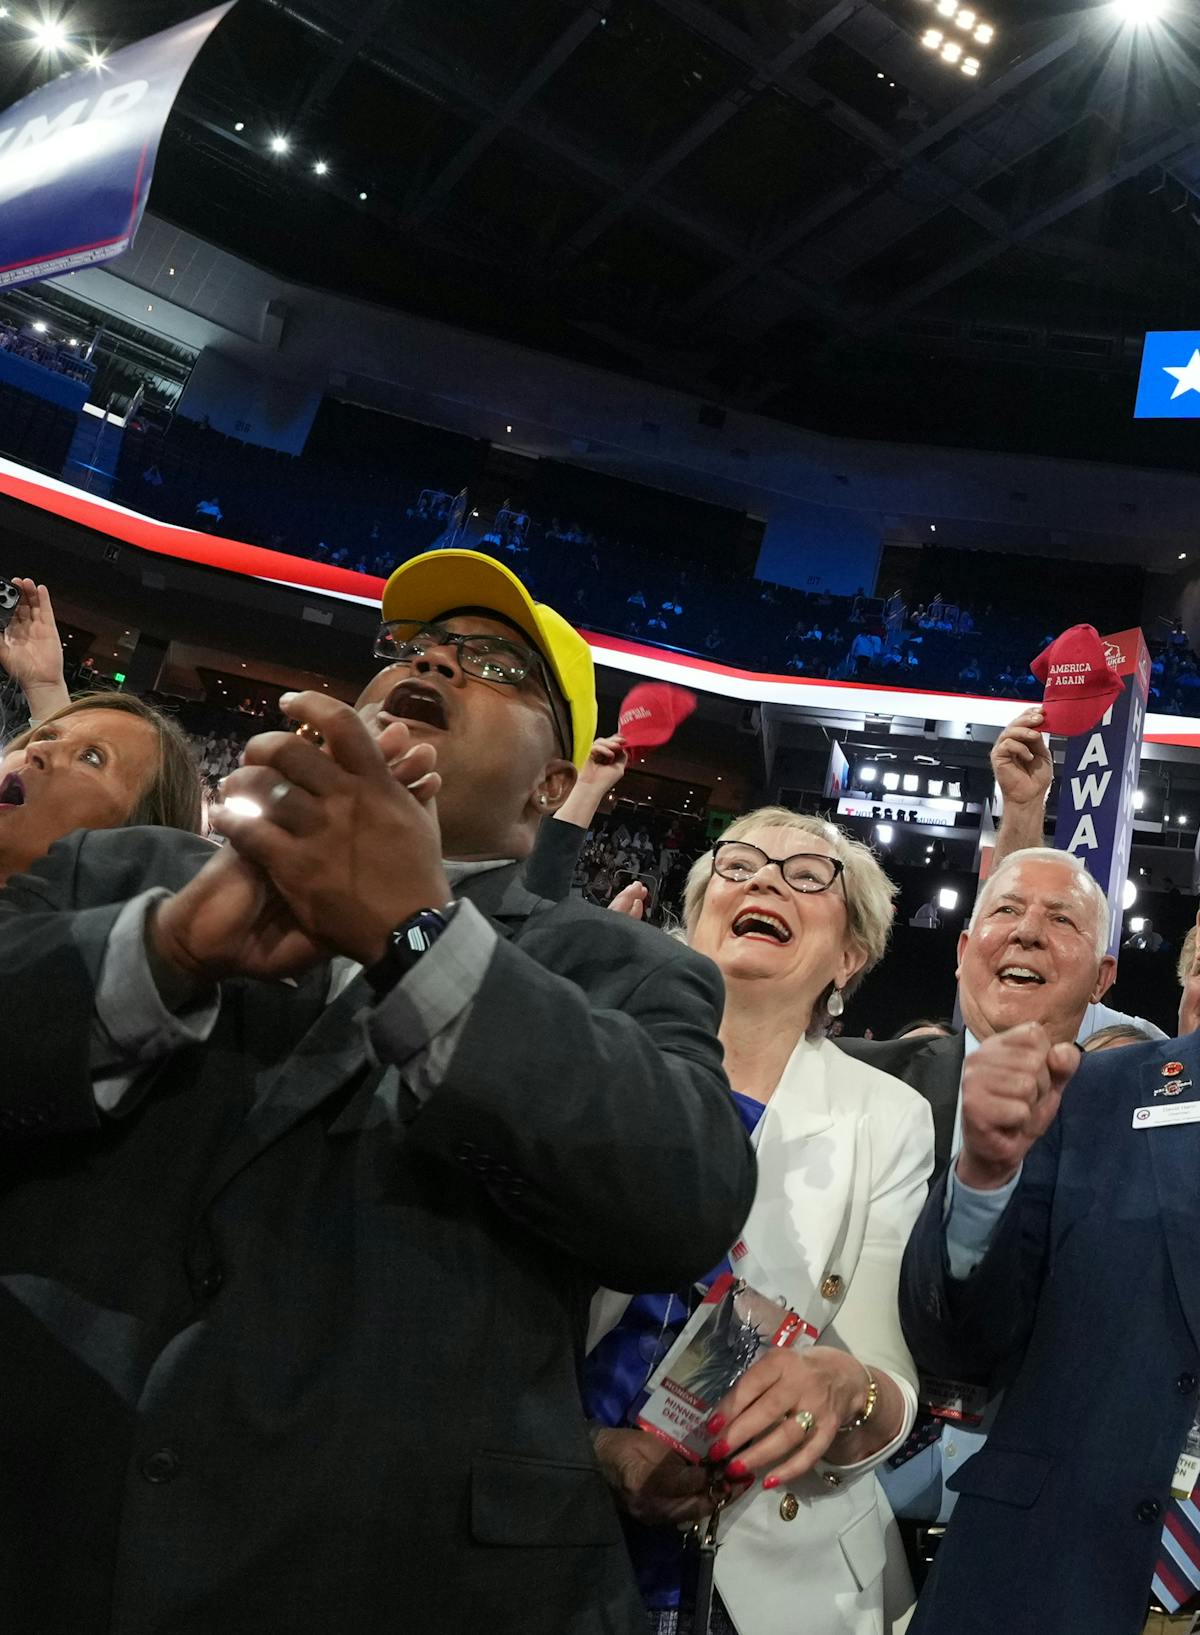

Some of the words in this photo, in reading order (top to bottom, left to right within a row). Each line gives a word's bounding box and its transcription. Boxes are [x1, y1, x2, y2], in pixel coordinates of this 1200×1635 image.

[1050, 663, 1091, 674] AMERICA
[1055, 675, 1085, 686] AGAIN
[664, 1382, 698, 1406] MONDAY
